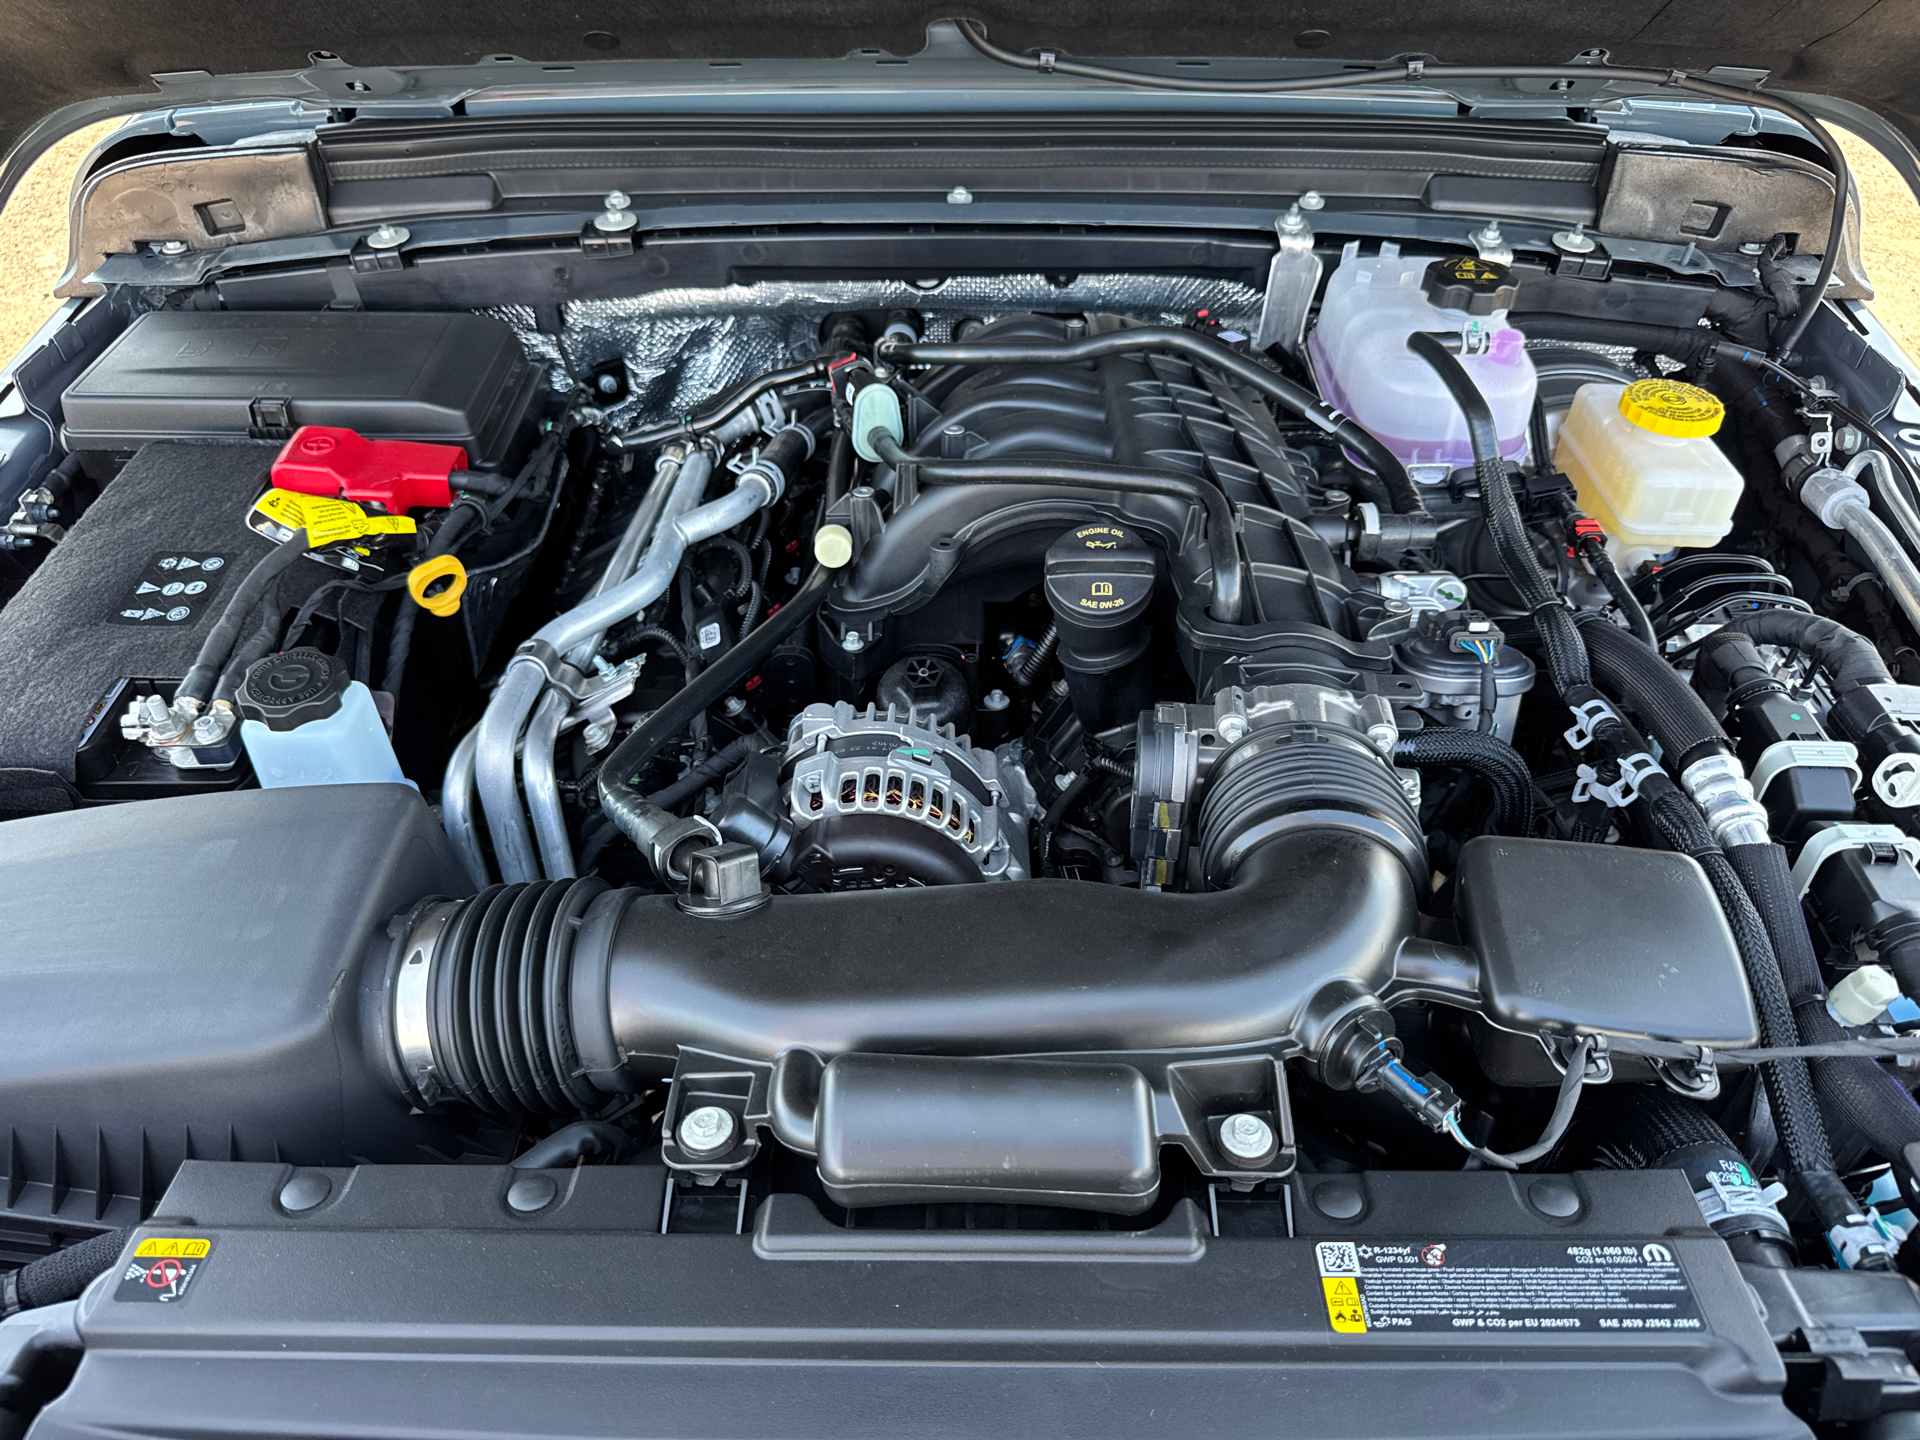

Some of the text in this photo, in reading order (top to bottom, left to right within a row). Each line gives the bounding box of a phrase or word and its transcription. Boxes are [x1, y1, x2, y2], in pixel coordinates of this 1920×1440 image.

[1076, 528, 1124, 538] ENGINE OIL
[1080, 598, 1124, 609] SAE 0W-20
[273, 652, 318, 664] STEERING
[252, 661, 272, 679] FLUID
[251, 687, 317, 704] USE APPROVED
[1373, 1246, 1411, 1255] R-1234yf
[1567, 1246, 1638, 1256] 482g (1.060 lb)
[1391, 1318, 1412, 1326] PAG
[1452, 1318, 1475, 1327] GWP
[1477, 1318, 1485, 1327] &
[1486, 1318, 1507, 1327] CO2
[1508, 1320, 1523, 1328] per
[1524, 1318, 1538, 1327] EU
[1599, 1318, 1620, 1328] SAE
[1622, 1318, 1644, 1328] J639
